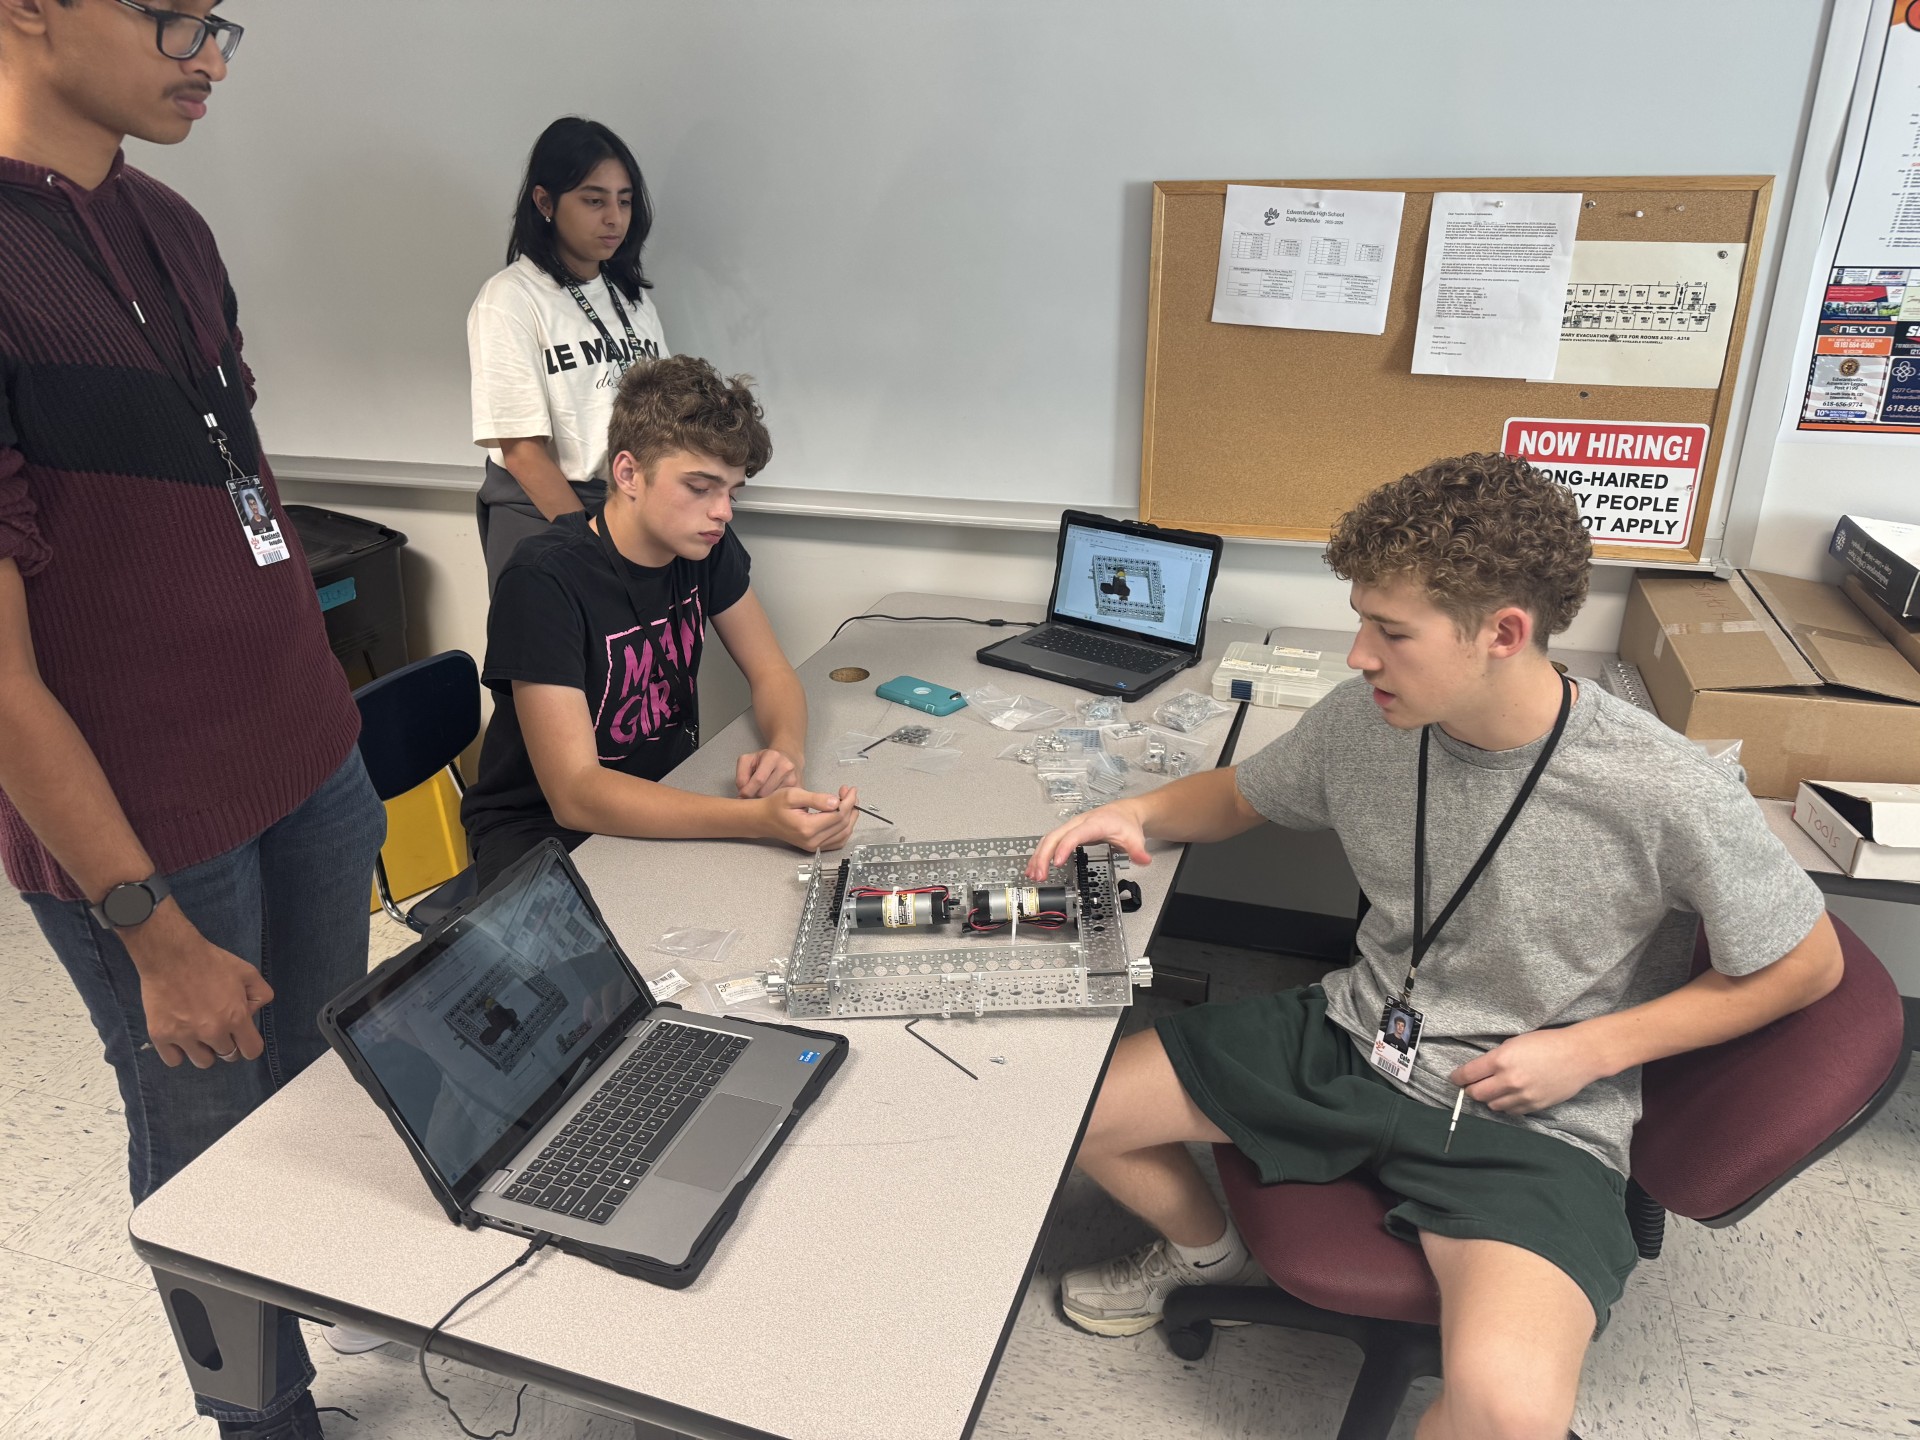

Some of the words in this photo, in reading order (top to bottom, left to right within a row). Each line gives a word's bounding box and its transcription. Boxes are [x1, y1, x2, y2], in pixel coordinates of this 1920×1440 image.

[1839, 326, 1886, 334] NEVCO
[544, 344, 577, 374] LE
[579, 338, 659, 366] MAISO
[1518, 430, 1581, 456] NOW
[1586, 433, 1692, 461] HIRING!
[1541, 469, 1669, 489] ONG-HAIRED
[1596, 494, 1679, 512] PEOPLE
[1580, 516, 1607, 531] OT
[1610, 518, 1679, 535] APPLY
[1808, 802, 1840, 848] Tools
[1399, 1053, 1410, 1064] Cole
